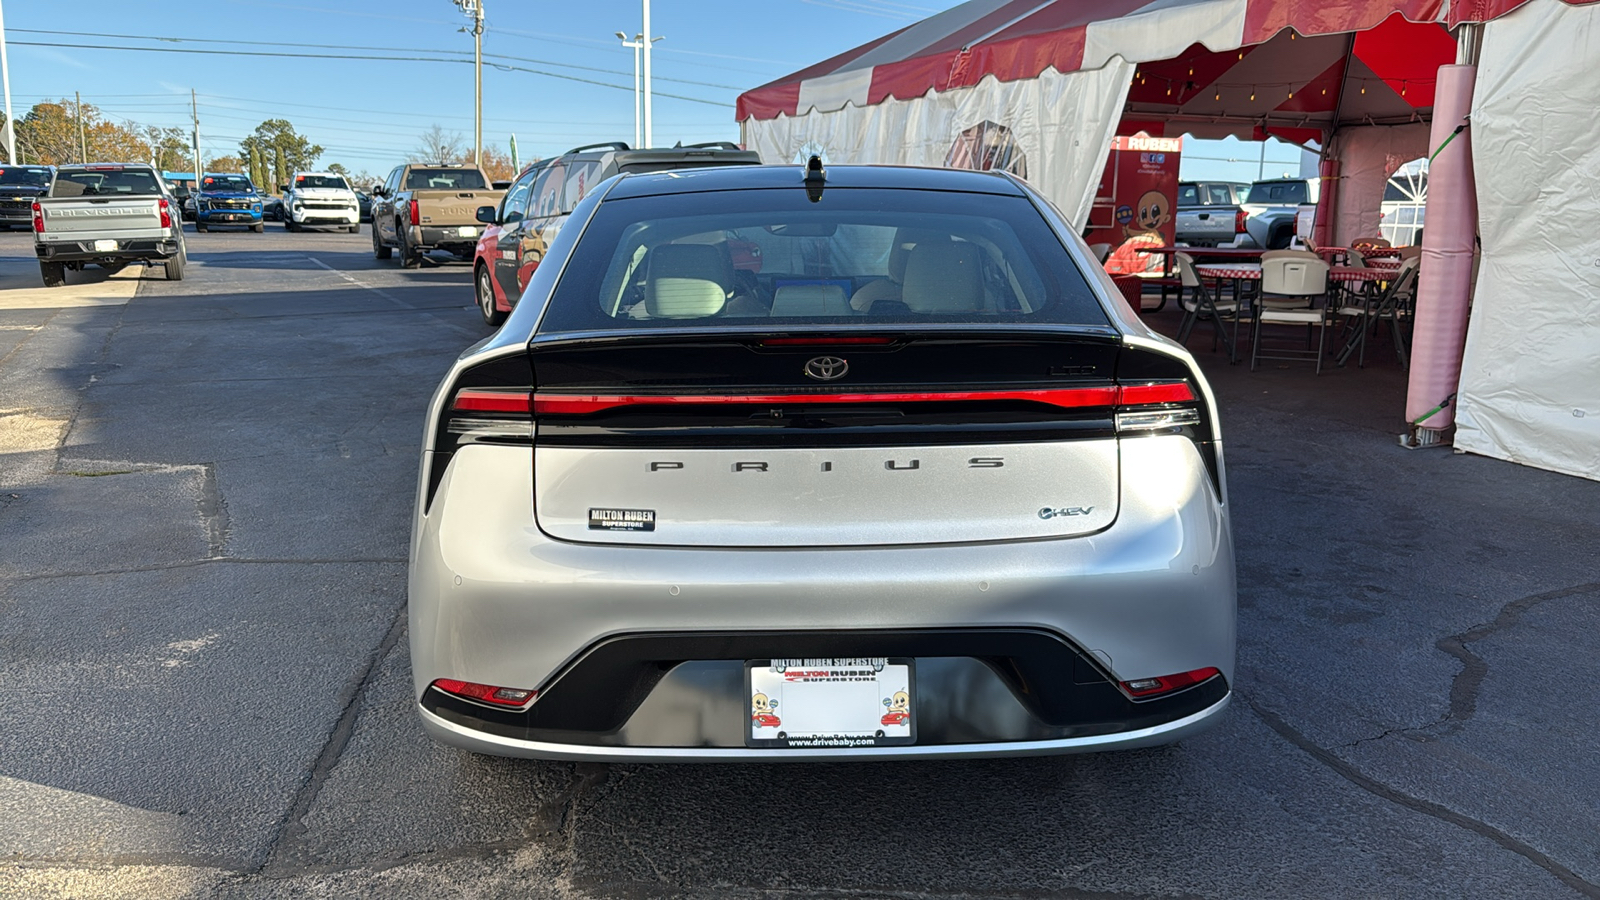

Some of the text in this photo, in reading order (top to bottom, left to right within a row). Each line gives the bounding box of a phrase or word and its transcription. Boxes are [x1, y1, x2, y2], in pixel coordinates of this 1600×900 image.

[1128, 137, 1180, 152] RUBEN
[48, 207, 153, 217] CHEVROLET
[440, 206, 476, 216] TUND
[650, 457, 1005, 473] PRIUS
[591, 509, 653, 522] MILTON RUBEN
[770, 657, 889, 667] MILTON RUBEN SUPERSTORE
[788, 739, 875, 747] www.drivebaby.com
